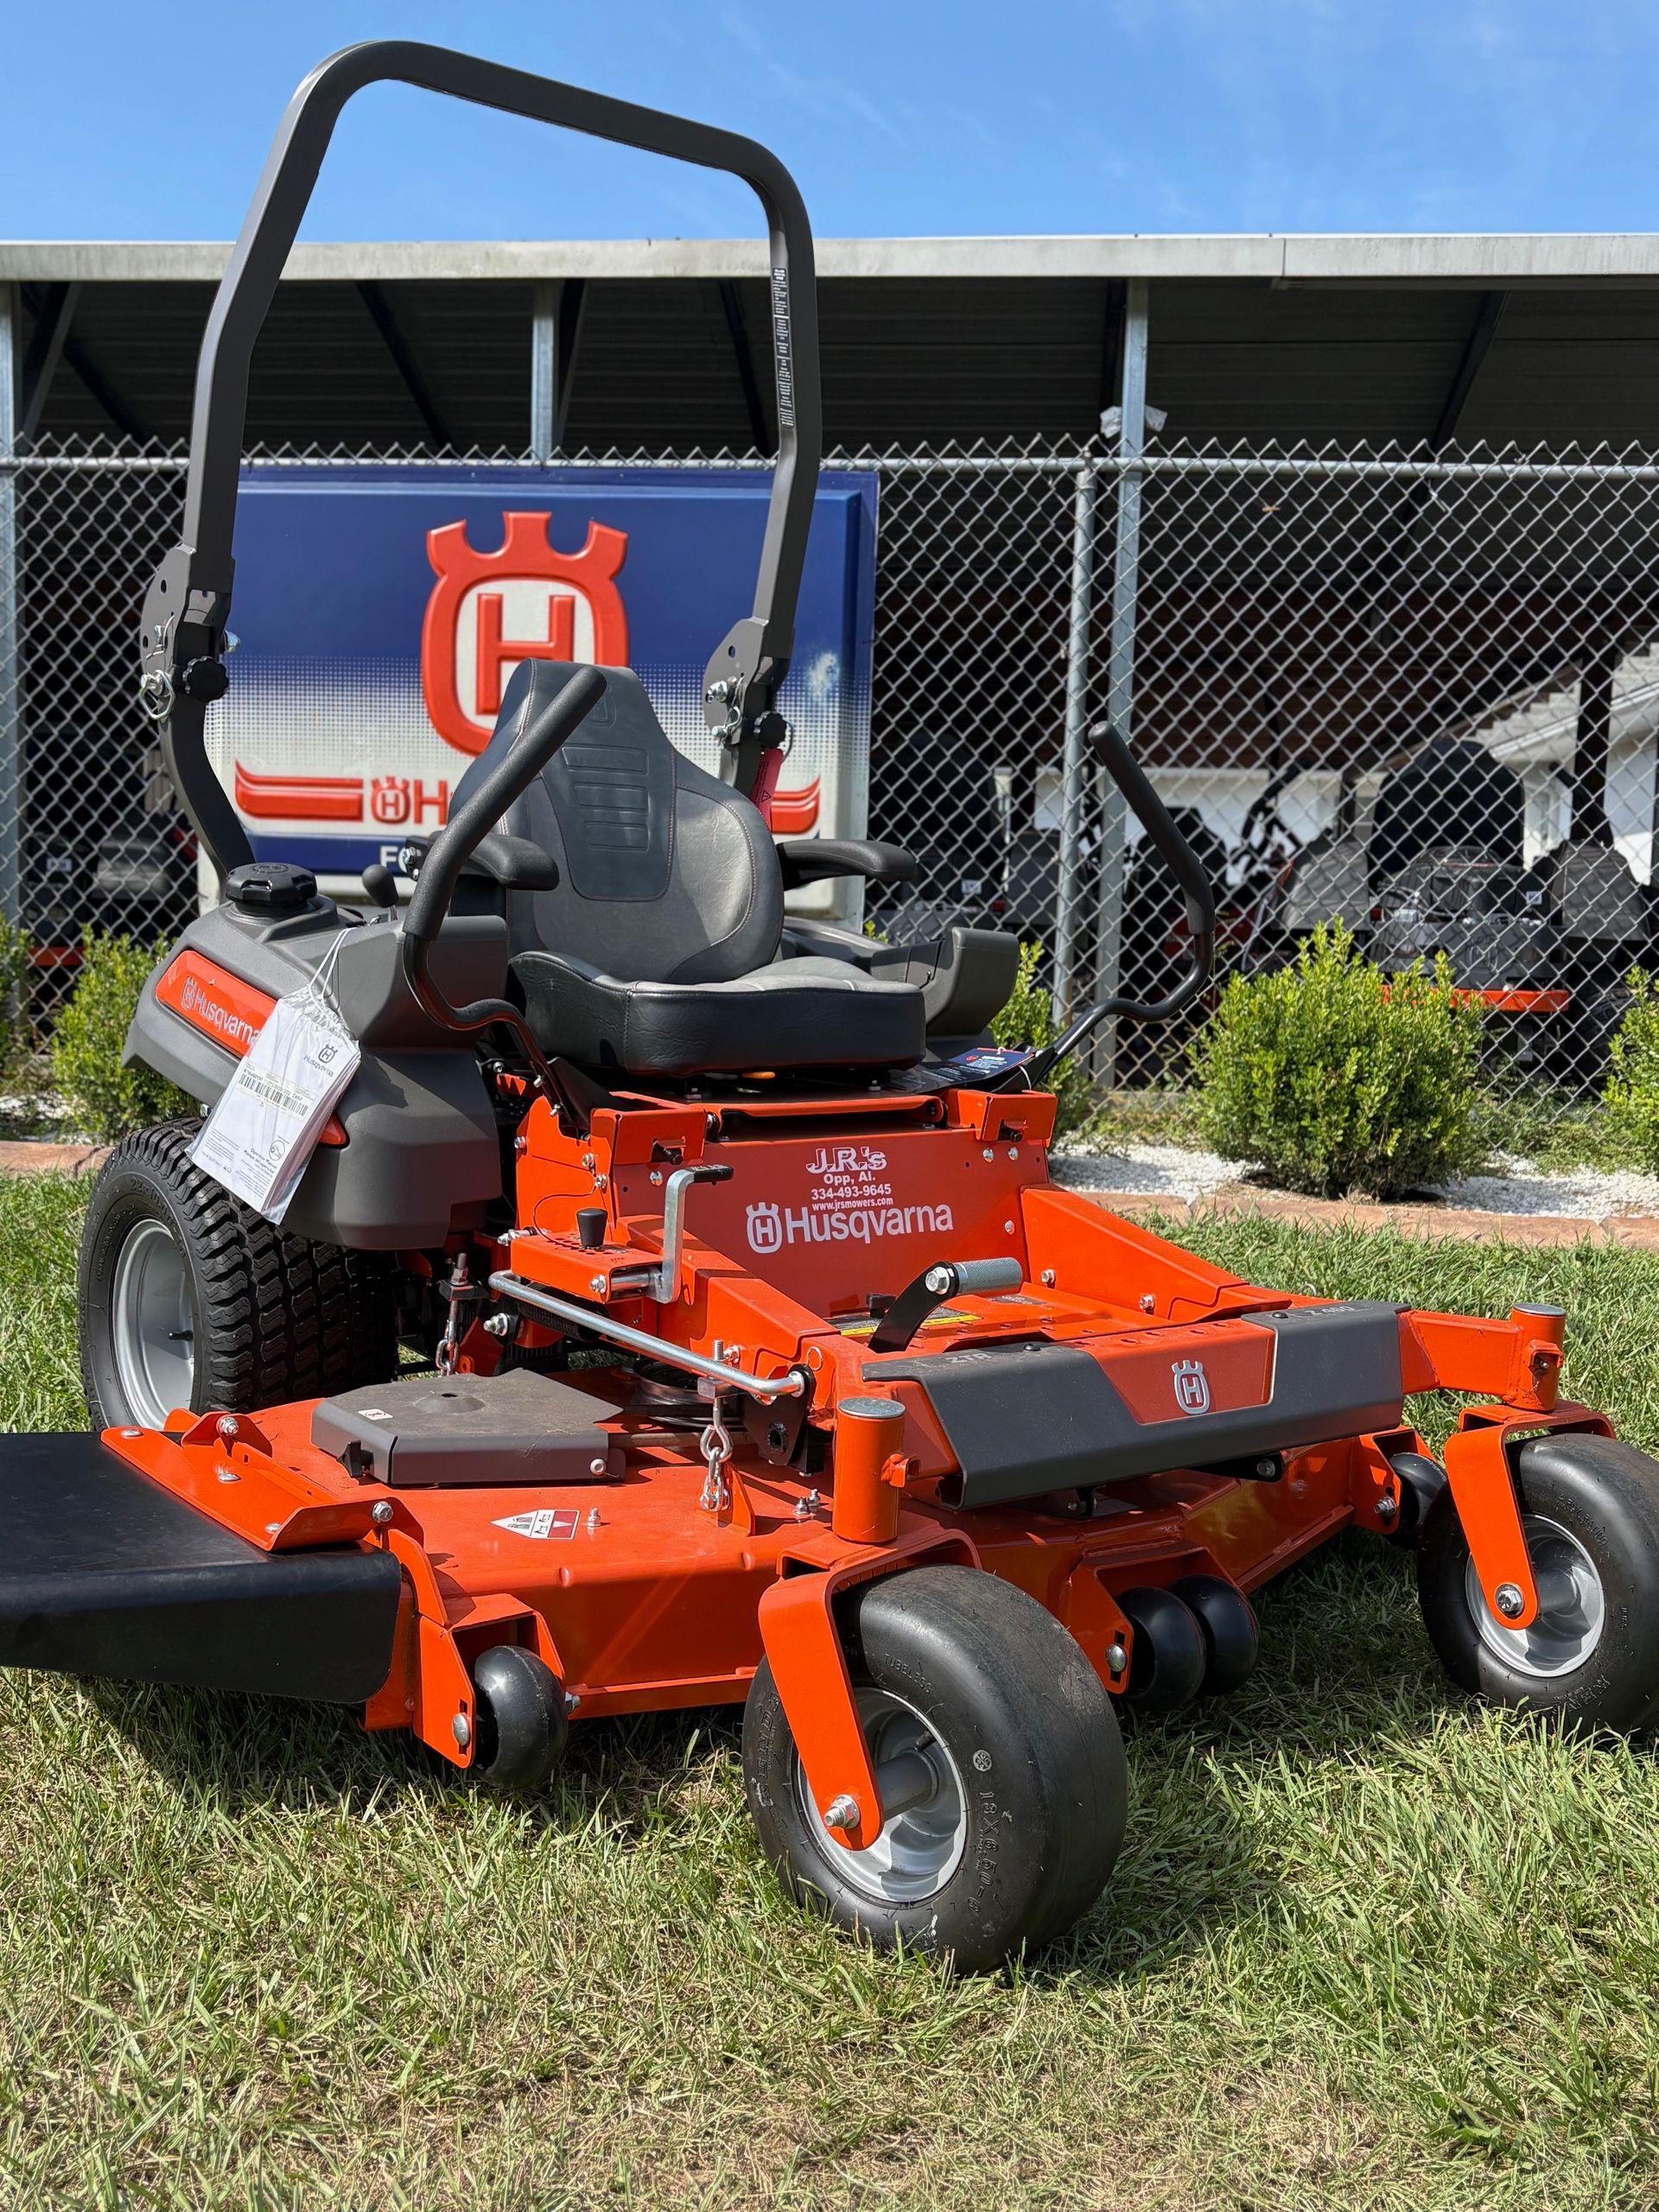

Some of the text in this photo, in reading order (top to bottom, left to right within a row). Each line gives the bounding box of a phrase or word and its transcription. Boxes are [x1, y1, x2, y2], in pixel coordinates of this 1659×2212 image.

[194, 988, 261, 1046] Husqvarna
[823, 1173, 855, 1185] Opp,
[811, 1183, 892, 1200] 334-493-9645
[812, 1197, 893, 1212] www.jrsmowers.com
[785, 1204, 954, 1244] Husqvarna
[944, 1352, 993, 1363] ZTR
[884, 1653, 933, 1694] TUBELESS
